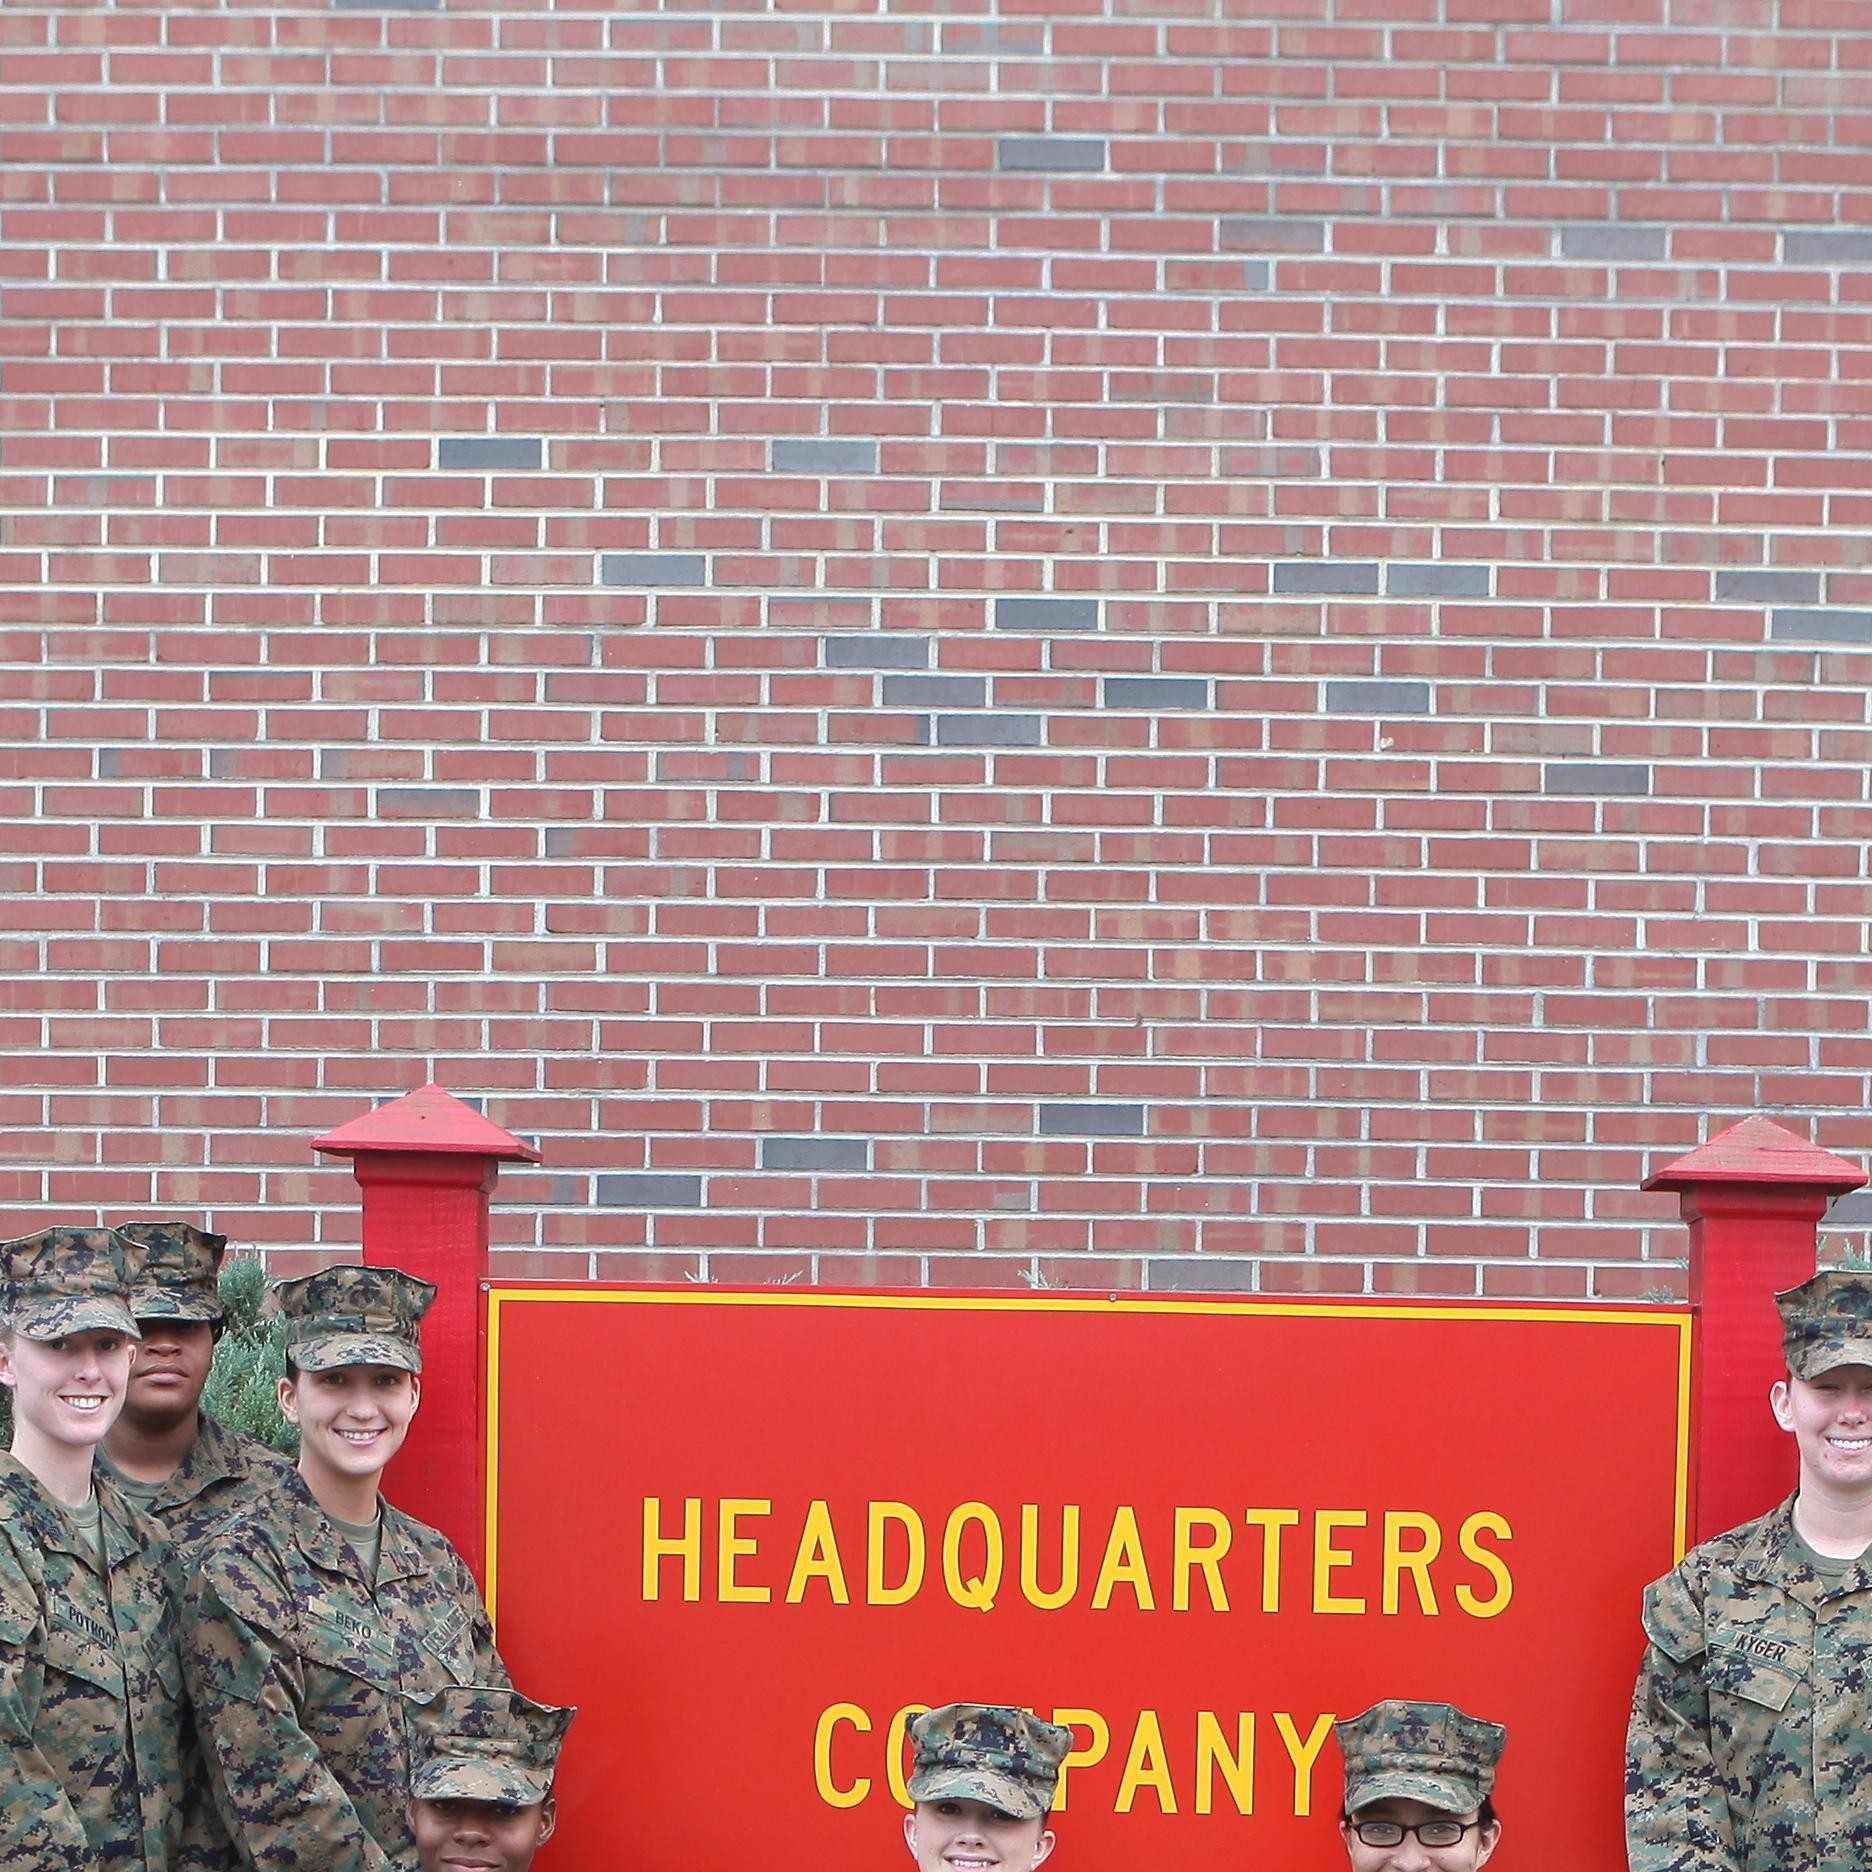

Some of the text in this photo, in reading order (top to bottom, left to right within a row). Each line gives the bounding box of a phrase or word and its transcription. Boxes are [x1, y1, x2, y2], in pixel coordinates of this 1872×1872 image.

[642, 1496, 1514, 1619] HEADQUARTERS
[335, 1610, 372, 1639] BEKO
[1735, 1633, 1786, 1661] KYGER
[813, 1702, 1336, 1817] CPANY
